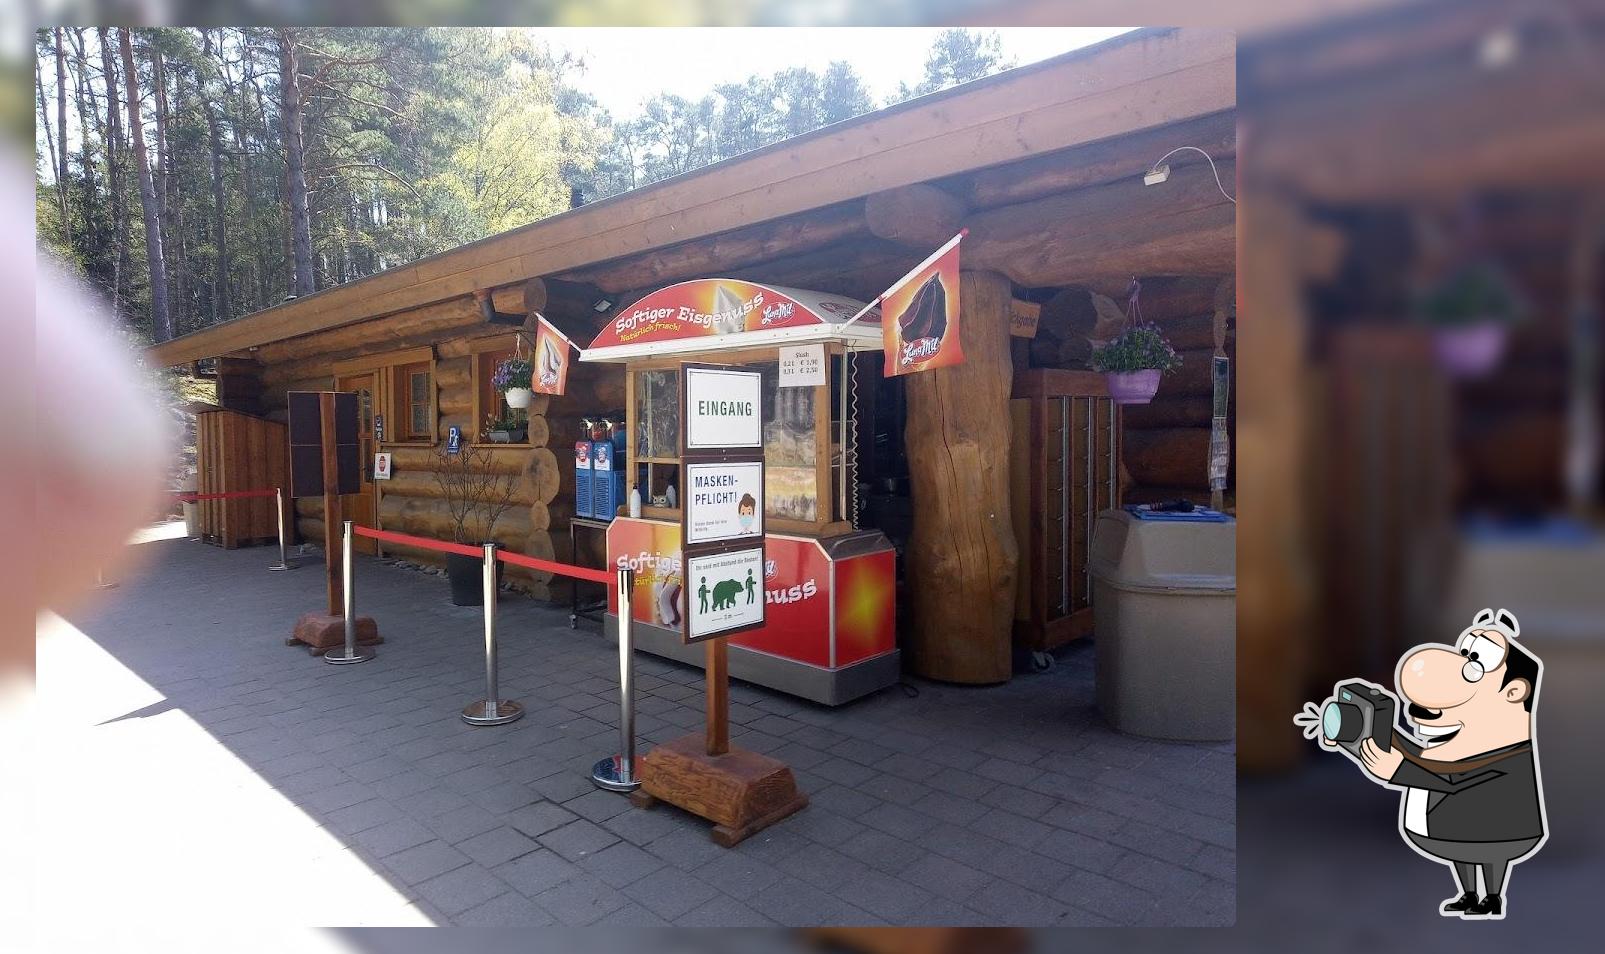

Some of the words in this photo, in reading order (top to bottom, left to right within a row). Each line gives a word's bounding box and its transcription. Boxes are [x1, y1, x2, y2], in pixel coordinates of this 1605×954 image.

[615, 307, 675, 335] Softiger
[677, 291, 764, 328] Eisgenuss
[620, 324, 654, 341] Natürlich
[654, 321, 681, 332] frisch!
[698, 400, 752, 416] EINGANG
[695, 475, 738, 488] MASKEN-
[695, 492, 737, 506] PFLICHT!
[616, 552, 682, 574] Softige
[765, 579, 817, 604] nuss
